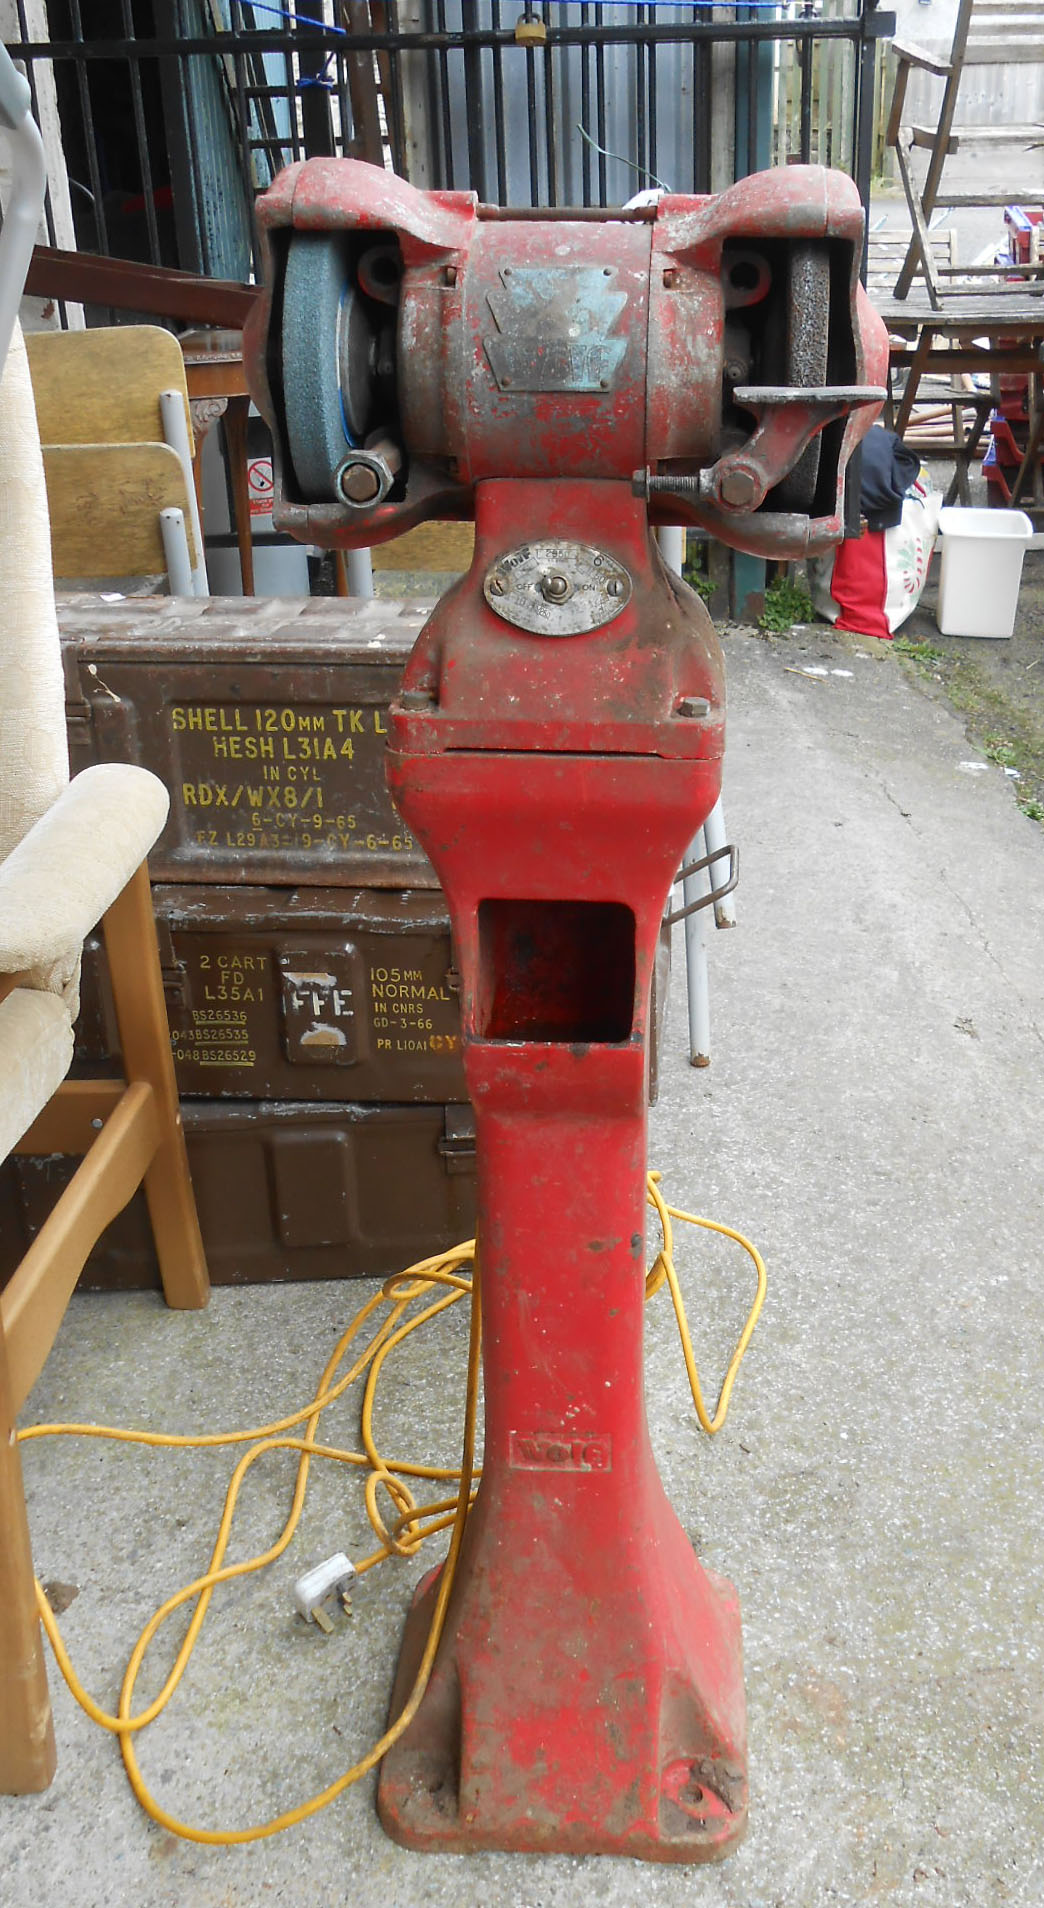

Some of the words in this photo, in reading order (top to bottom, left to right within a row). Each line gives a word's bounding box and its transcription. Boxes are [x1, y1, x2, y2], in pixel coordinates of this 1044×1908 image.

[516, 583, 533, 591] OFF
[582, 583, 596, 591] ON
[171, 707, 248, 731] SHELL
[332, 709, 364, 733] TK
[212, 736, 275, 759] HESH
[283, 737, 355, 760] L31A4
[263, 765, 280, 780] IN
[287, 766, 321, 781] CYL
[200, 955, 211, 969] 2
[217, 956, 268, 970] CART
[221, 971, 244, 985] FD
[204, 985, 264, 1002] L35A1
[371, 984, 450, 1001] NORMAL
[374, 1002, 388, 1013] IN
[392, 1003, 424, 1014] CNRS
[192, 1010, 248, 1022] BS26536
[376, 1038, 393, 1050] PR
